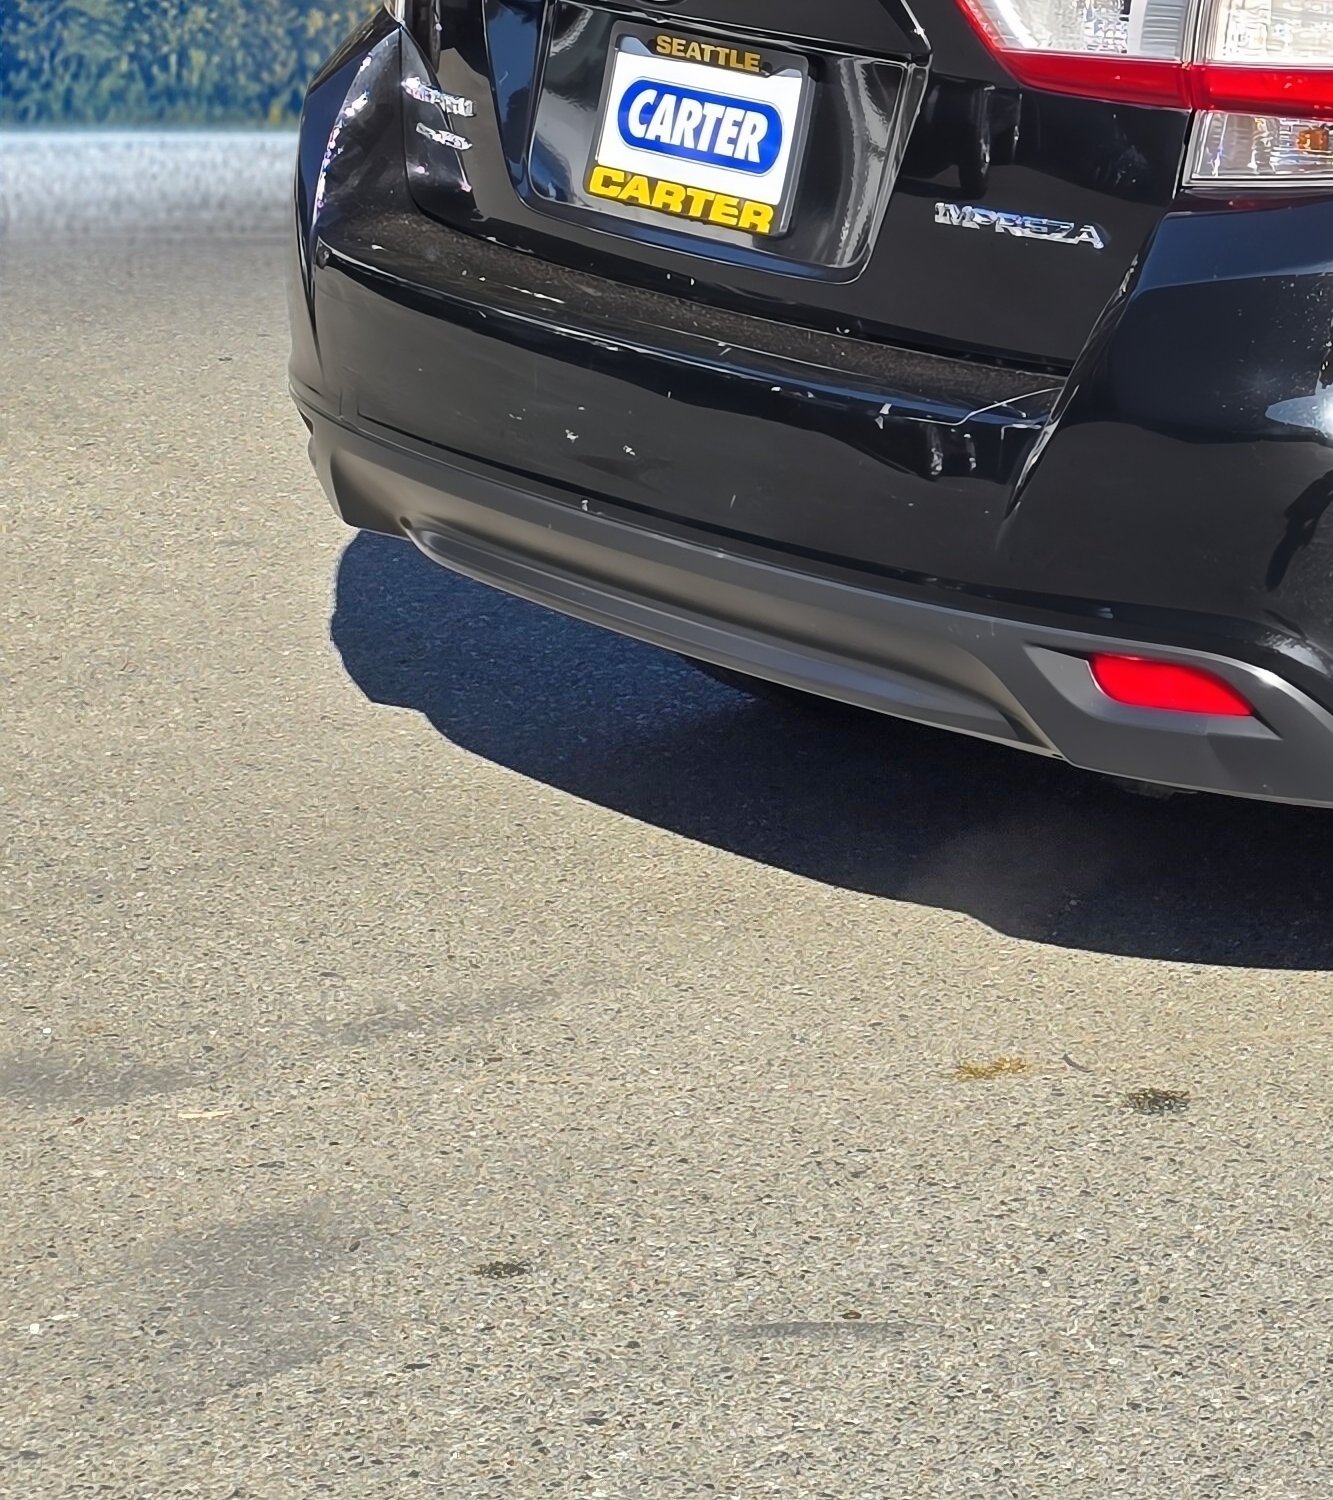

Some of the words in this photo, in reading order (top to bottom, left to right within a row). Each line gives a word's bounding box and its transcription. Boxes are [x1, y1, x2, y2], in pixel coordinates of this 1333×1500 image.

[655, 34, 762, 73] SEATTLE
[627, 88, 769, 164] CARTER
[588, 165, 775, 235] CARTER
[933, 201, 1105, 250] IMPREZA
